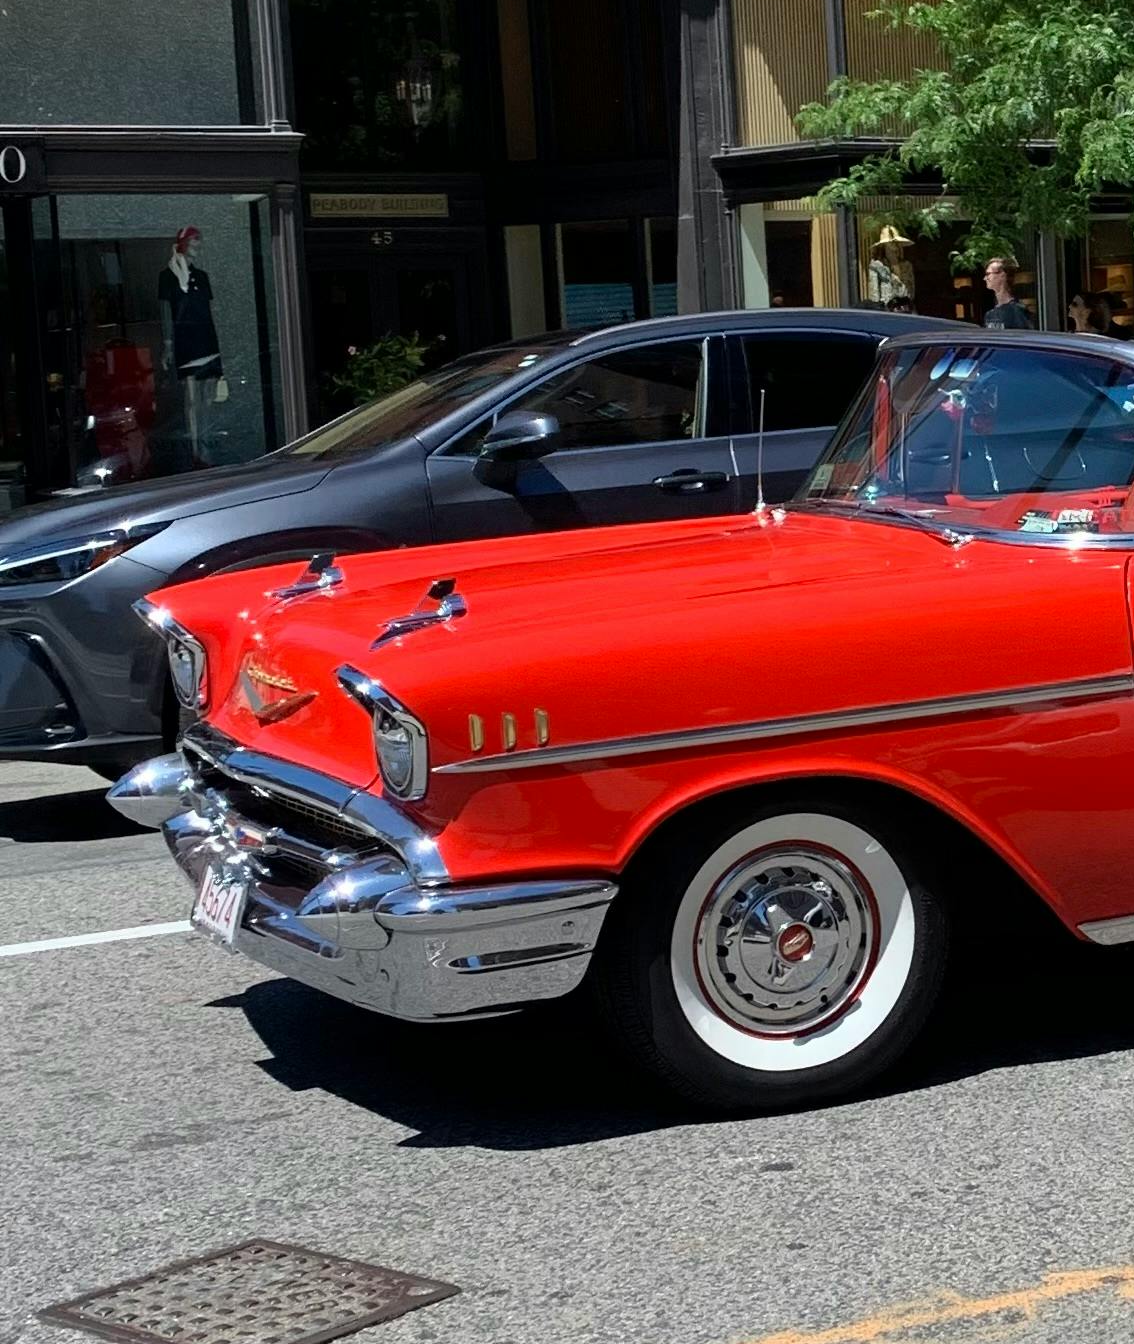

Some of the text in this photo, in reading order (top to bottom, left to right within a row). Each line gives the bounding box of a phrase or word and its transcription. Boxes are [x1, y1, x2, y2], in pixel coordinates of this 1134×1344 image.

[0, 146, 26, 183] O
[312, 198, 377, 211] PEABODY
[371, 231, 393, 245] 45
